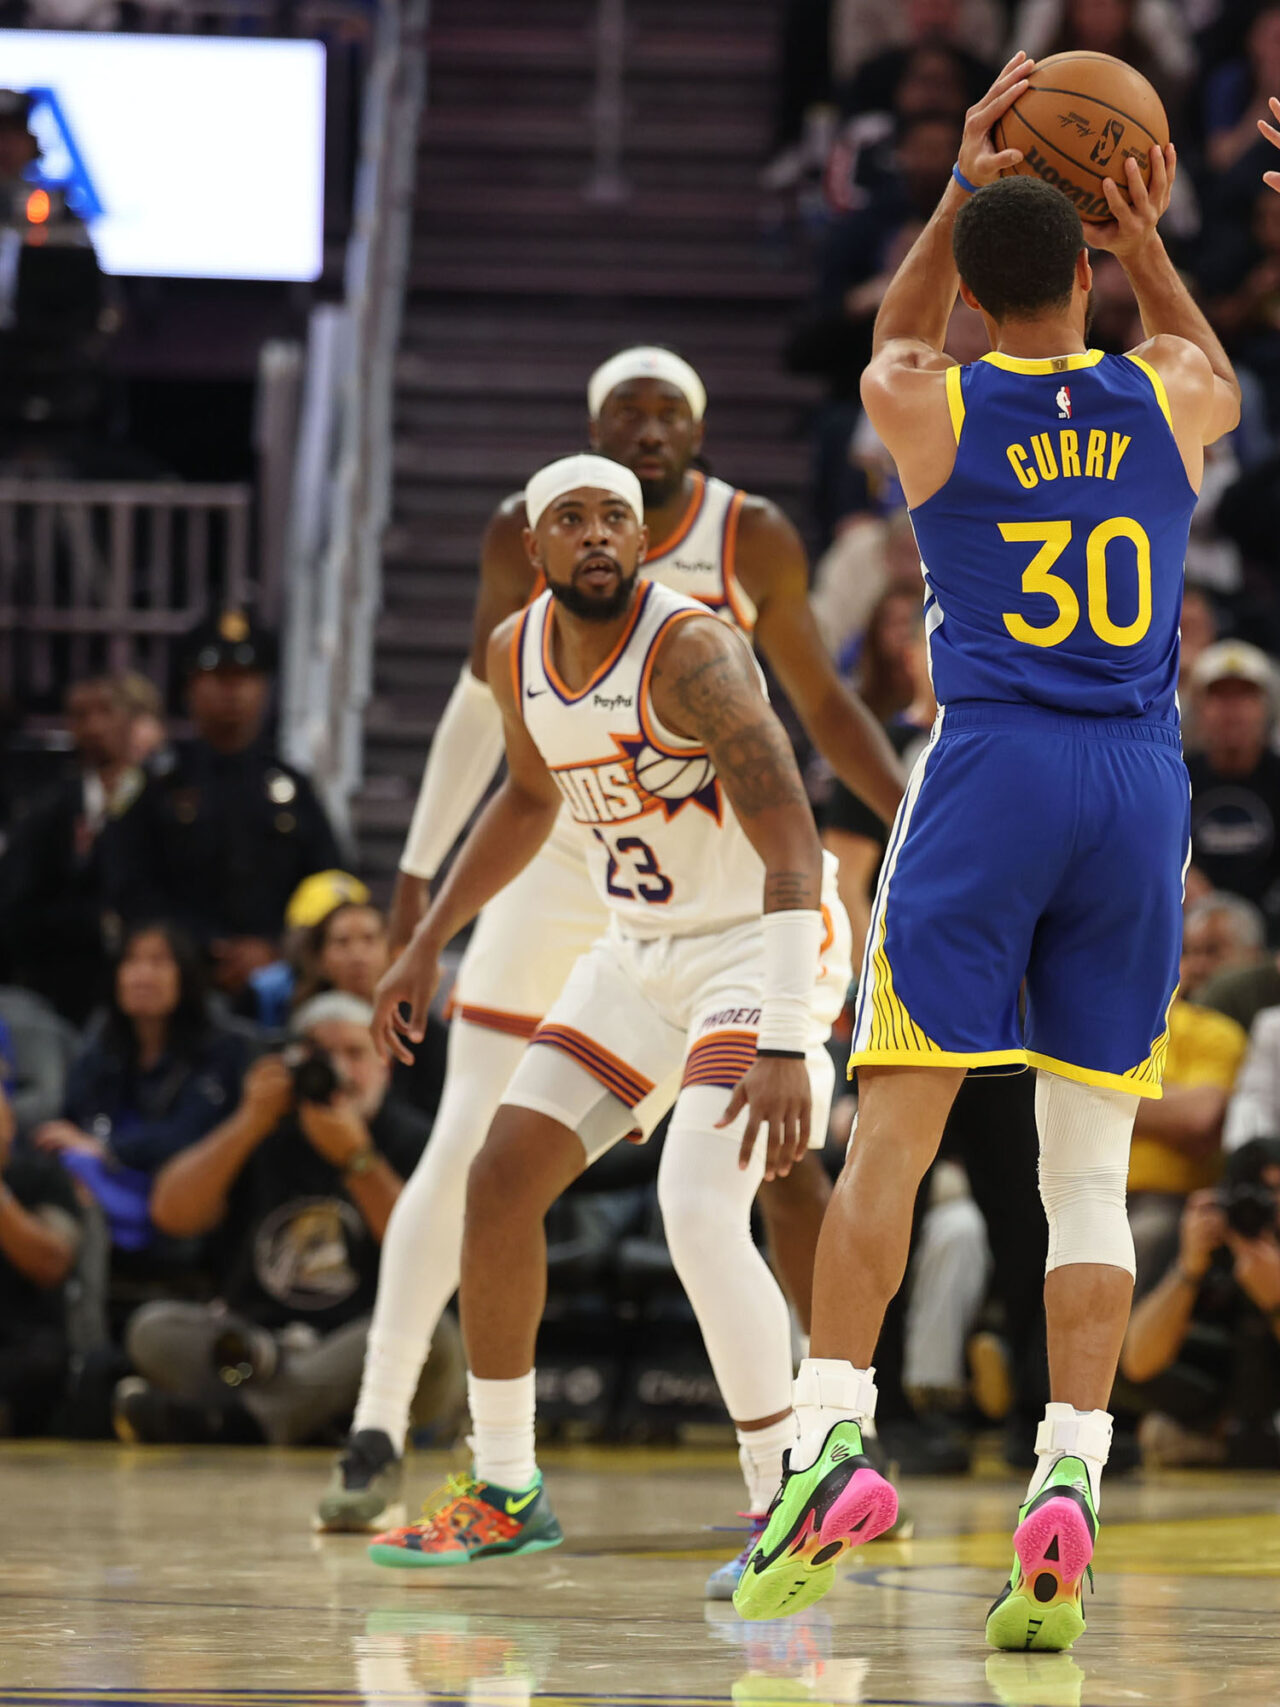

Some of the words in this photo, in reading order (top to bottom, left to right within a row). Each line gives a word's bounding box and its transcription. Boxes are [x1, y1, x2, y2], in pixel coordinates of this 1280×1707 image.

[1006, 429, 1132, 489] CURRY
[996, 516, 1152, 648] 30
[594, 694, 632, 711] PayPal
[550, 762, 643, 823] UNS
[592, 828, 674, 904] 23
